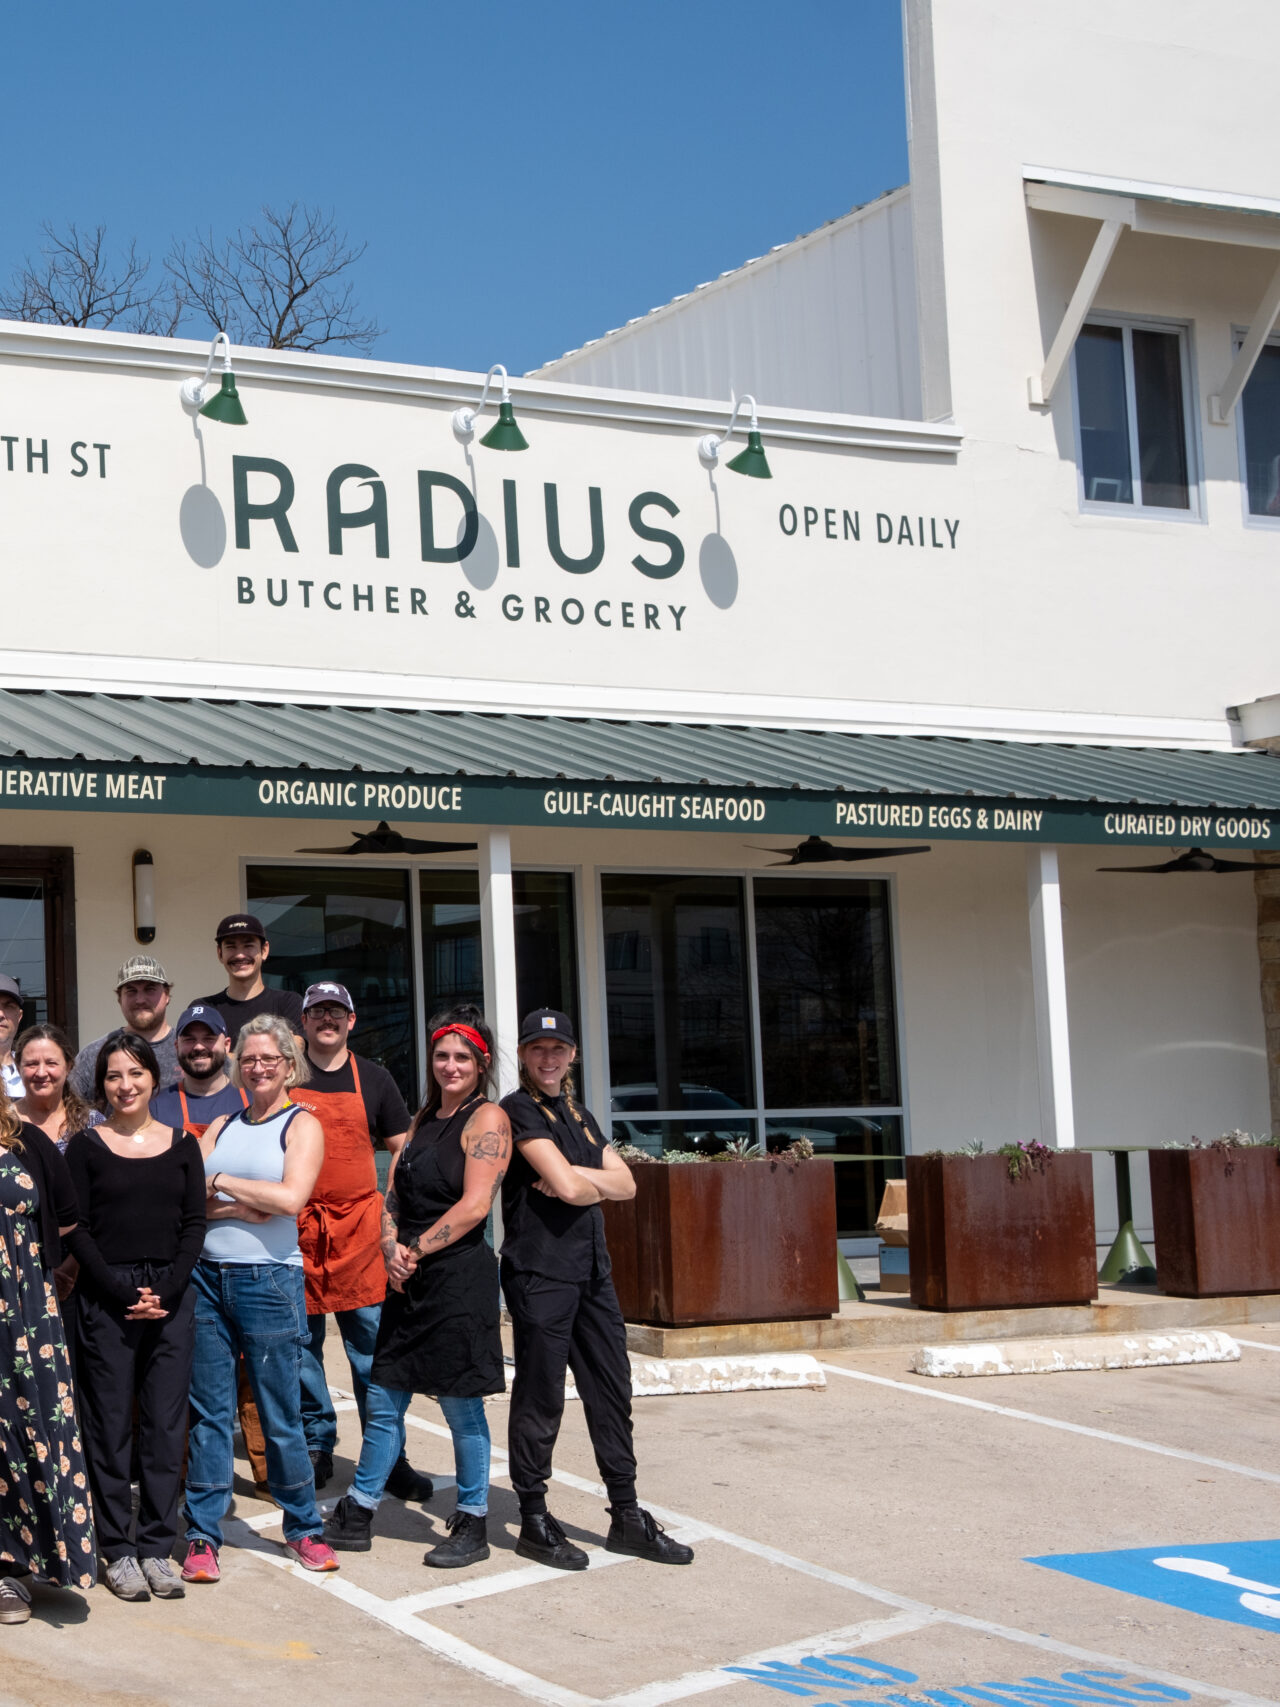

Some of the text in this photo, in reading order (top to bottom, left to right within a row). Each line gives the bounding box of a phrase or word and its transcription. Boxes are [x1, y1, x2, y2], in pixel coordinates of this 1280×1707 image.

[71, 442, 110, 478] ST
[233, 456, 684, 580] RADIUS
[780, 504, 959, 548] OPEN DAILY
[238, 577, 686, 630] BUTCHER & GROCERY
[106, 775, 166, 799] MEAT
[259, 780, 461, 810] ORGANIC PRODUCE
[544, 791, 765, 821] GULF-CAUGHT SEAFOOD
[837, 803, 1043, 831] PASTURED EGGS & DAIRY
[1105, 813, 1270, 838] CURATED DRY GOODS
[720, 1654, 919, 1696] NO
